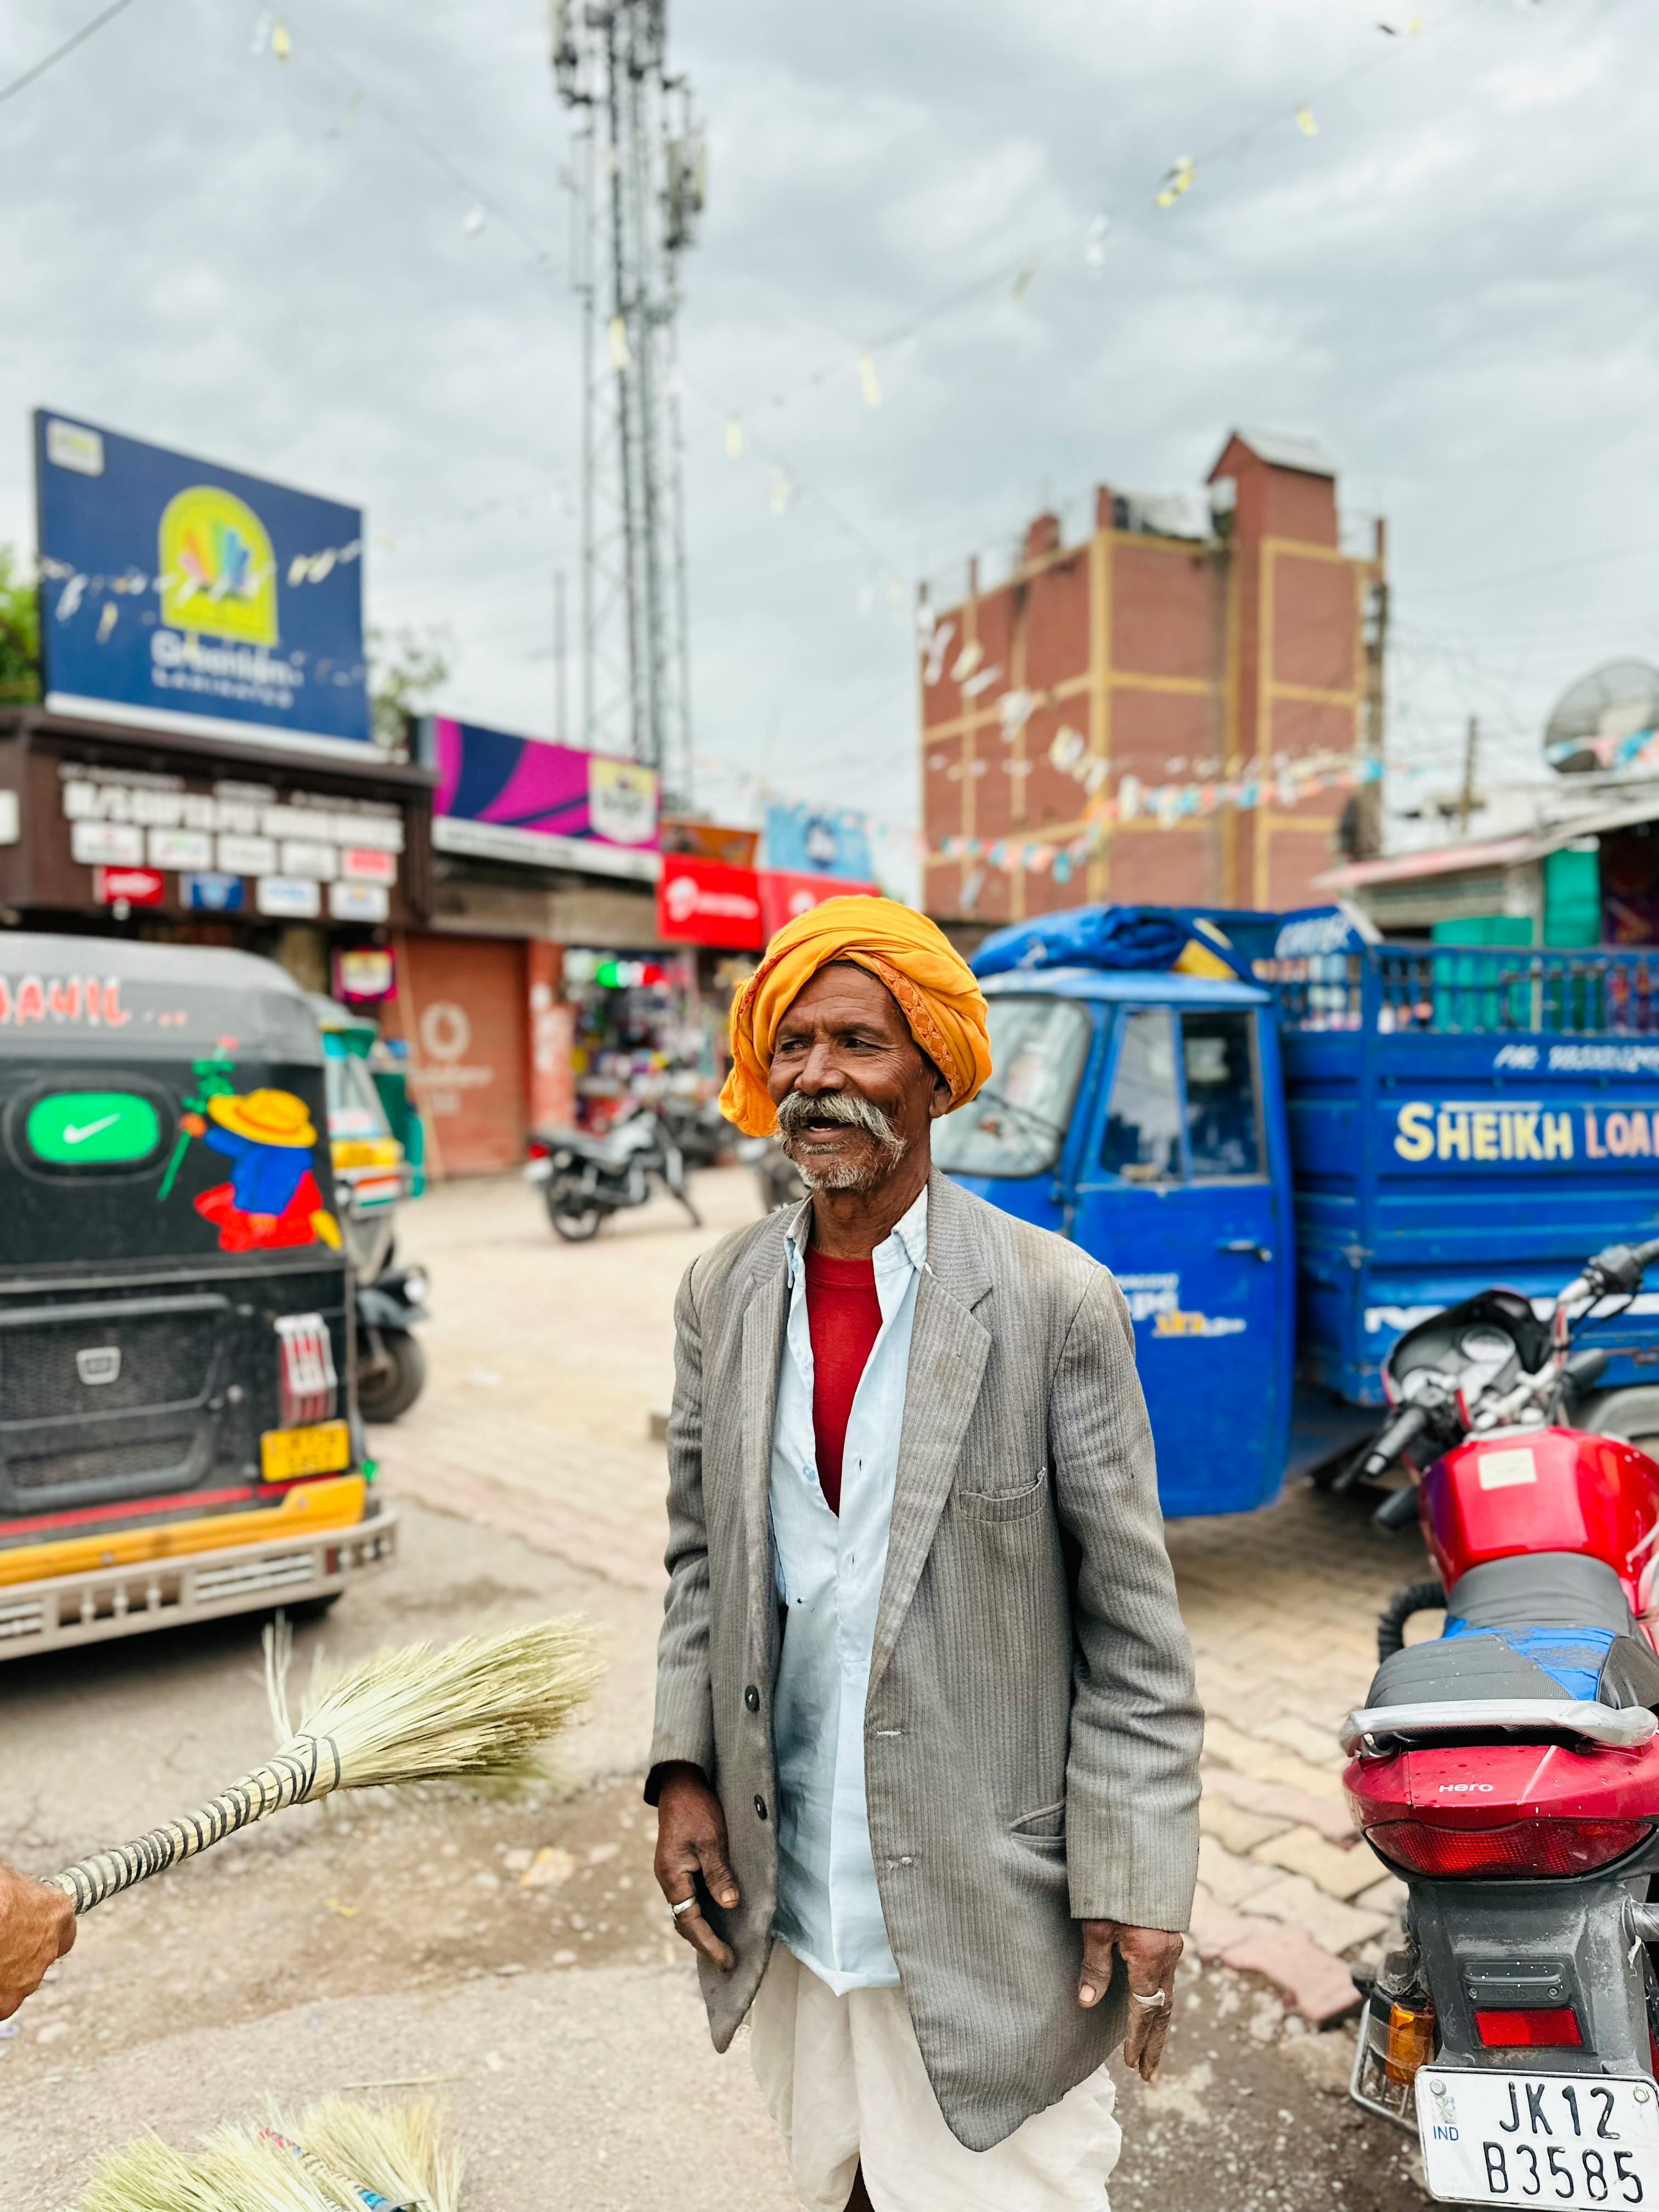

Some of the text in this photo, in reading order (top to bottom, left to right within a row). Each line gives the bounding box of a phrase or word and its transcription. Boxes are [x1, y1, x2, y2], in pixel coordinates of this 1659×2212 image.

[1395, 1102, 1659, 1161] SHEIKH LOA
[1438, 1784, 1494, 1793] Hero
[1433, 2126, 1459, 2141] IND
[1483, 2141, 1644, 2203] B3585
